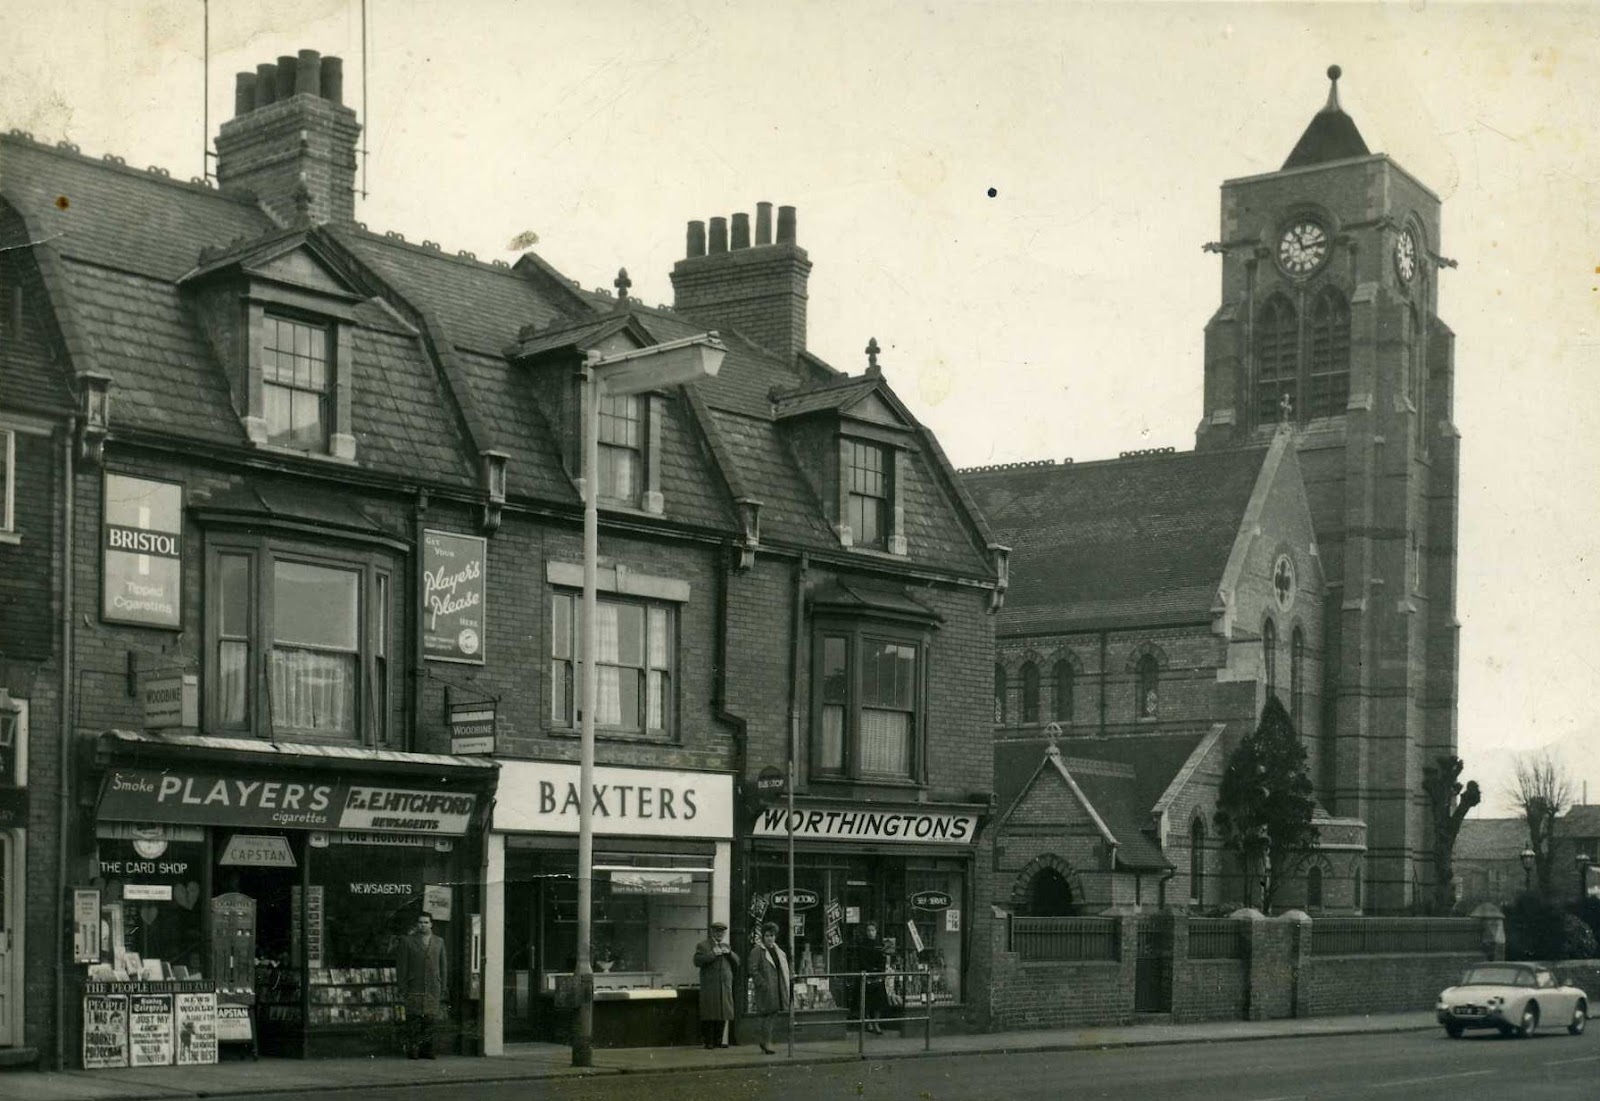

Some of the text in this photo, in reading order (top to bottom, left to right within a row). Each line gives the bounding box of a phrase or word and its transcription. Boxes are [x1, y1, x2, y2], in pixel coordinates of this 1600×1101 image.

[109, 529, 179, 555] BRISTOL
[424, 560, 480, 607] Player's
[431, 591, 480, 630] Please
[452, 724, 492, 736] WOODBINE
[112, 773, 155, 793] Smoke
[157, 776, 331, 811] PLAYER'S
[539, 780, 698, 821] BAXTERS
[272, 811, 327, 825] cigarettes
[372, 818, 439, 829] NEWSAGENTS
[765, 808, 969, 839] WORTHINGTON'S
[231, 849, 286, 861] CAPSTAN
[100, 861, 188, 875] THE CARD SHOP
[350, 883, 412, 894] NEWSAGENTS
[85, 982, 147, 993] THE PEOPLE
[88, 999, 126, 1011] PEOPLE
[94, 1012, 108, 1024] WAS
[157, 1015, 170, 1024] MY
[218, 1008, 249, 1018] APSTAN
